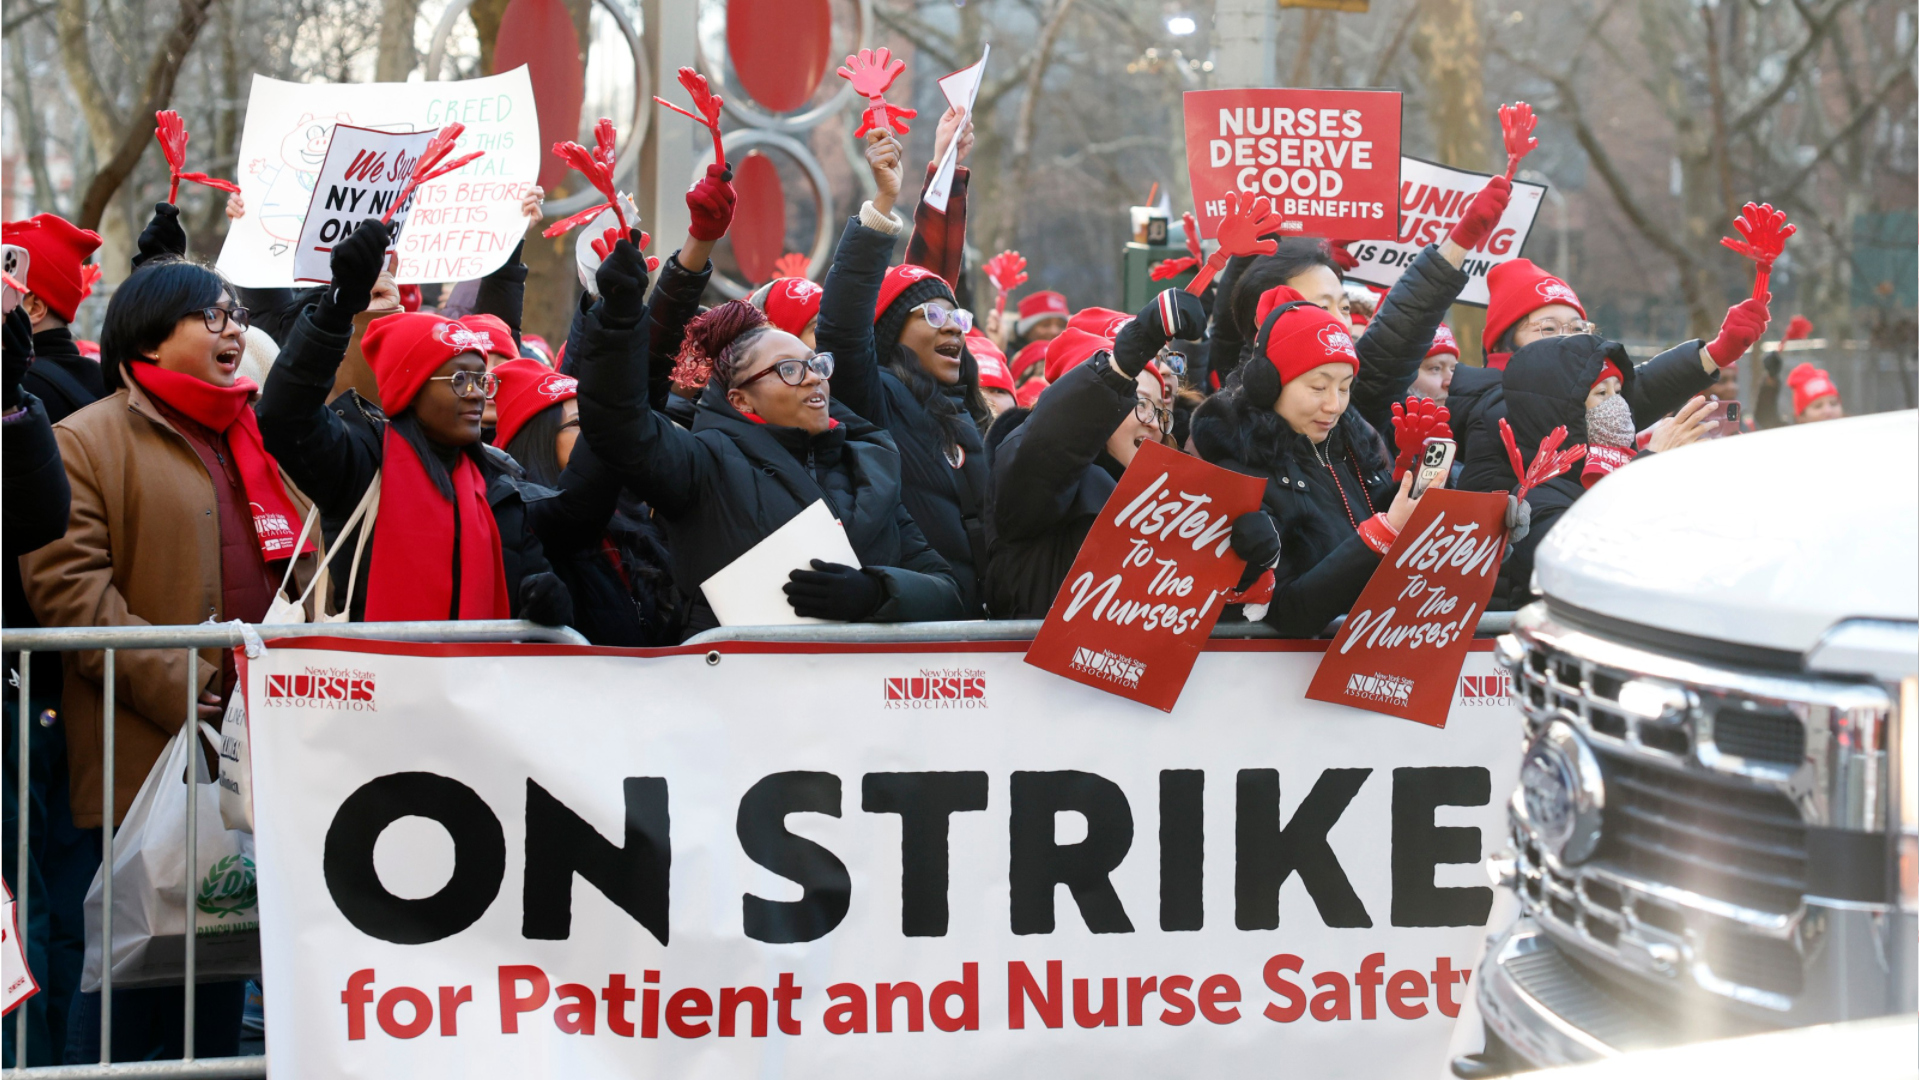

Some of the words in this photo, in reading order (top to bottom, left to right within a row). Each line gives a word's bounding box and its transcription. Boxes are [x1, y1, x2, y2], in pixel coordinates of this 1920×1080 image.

[427, 95, 512, 124] GREED
[1219, 107, 1362, 138] NURSES
[476, 131, 514, 149] THIS
[1210, 138, 1373, 169] DESERVE
[344, 149, 387, 183] We
[455, 182, 530, 203] BEFORE
[1236, 167, 1343, 198] GOOD
[325, 185, 367, 212] NY
[1284, 199, 1384, 219] BENEFITS
[413, 206, 488, 226] PROFITS
[1354, 244, 1377, 261] IS
[423, 257, 483, 279] LIVES
[1123, 538, 1154, 568] To
[1148, 557, 1194, 597] The
[1062, 571, 1218, 635] Nurses!
[1398, 575, 1427, 601] To
[1417, 585, 1458, 616] The
[1339, 603, 1476, 655] Nurses!
[305, 666, 328, 676] New
[330, 667, 350, 678] York
[353, 669, 375, 680] State
[920, 668, 941, 677] New
[942, 668, 962, 677] York
[964, 668, 985, 677] State
[1069, 661, 1138, 690] ASSOCIATION
[1072, 646, 1145, 682] NURSES
[265, 675, 375, 702] NURSES
[884, 677, 986, 700] NURSES
[1344, 688, 1408, 707] ASSOCIATION
[1347, 673, 1413, 700] NURSES
[264, 698, 376, 712] ASSOCIATION
[884, 699, 987, 709] ASSOCIATION
[324, 771, 672, 947] ON
[736, 766, 1493, 944] STRIKE
[341, 968, 472, 1041] for
[498, 964, 802, 1039] Patient
[823, 962, 979, 1035] and
[1007, 960, 1242, 1030] Nurse
[1263, 952, 1475, 1024] Safet
